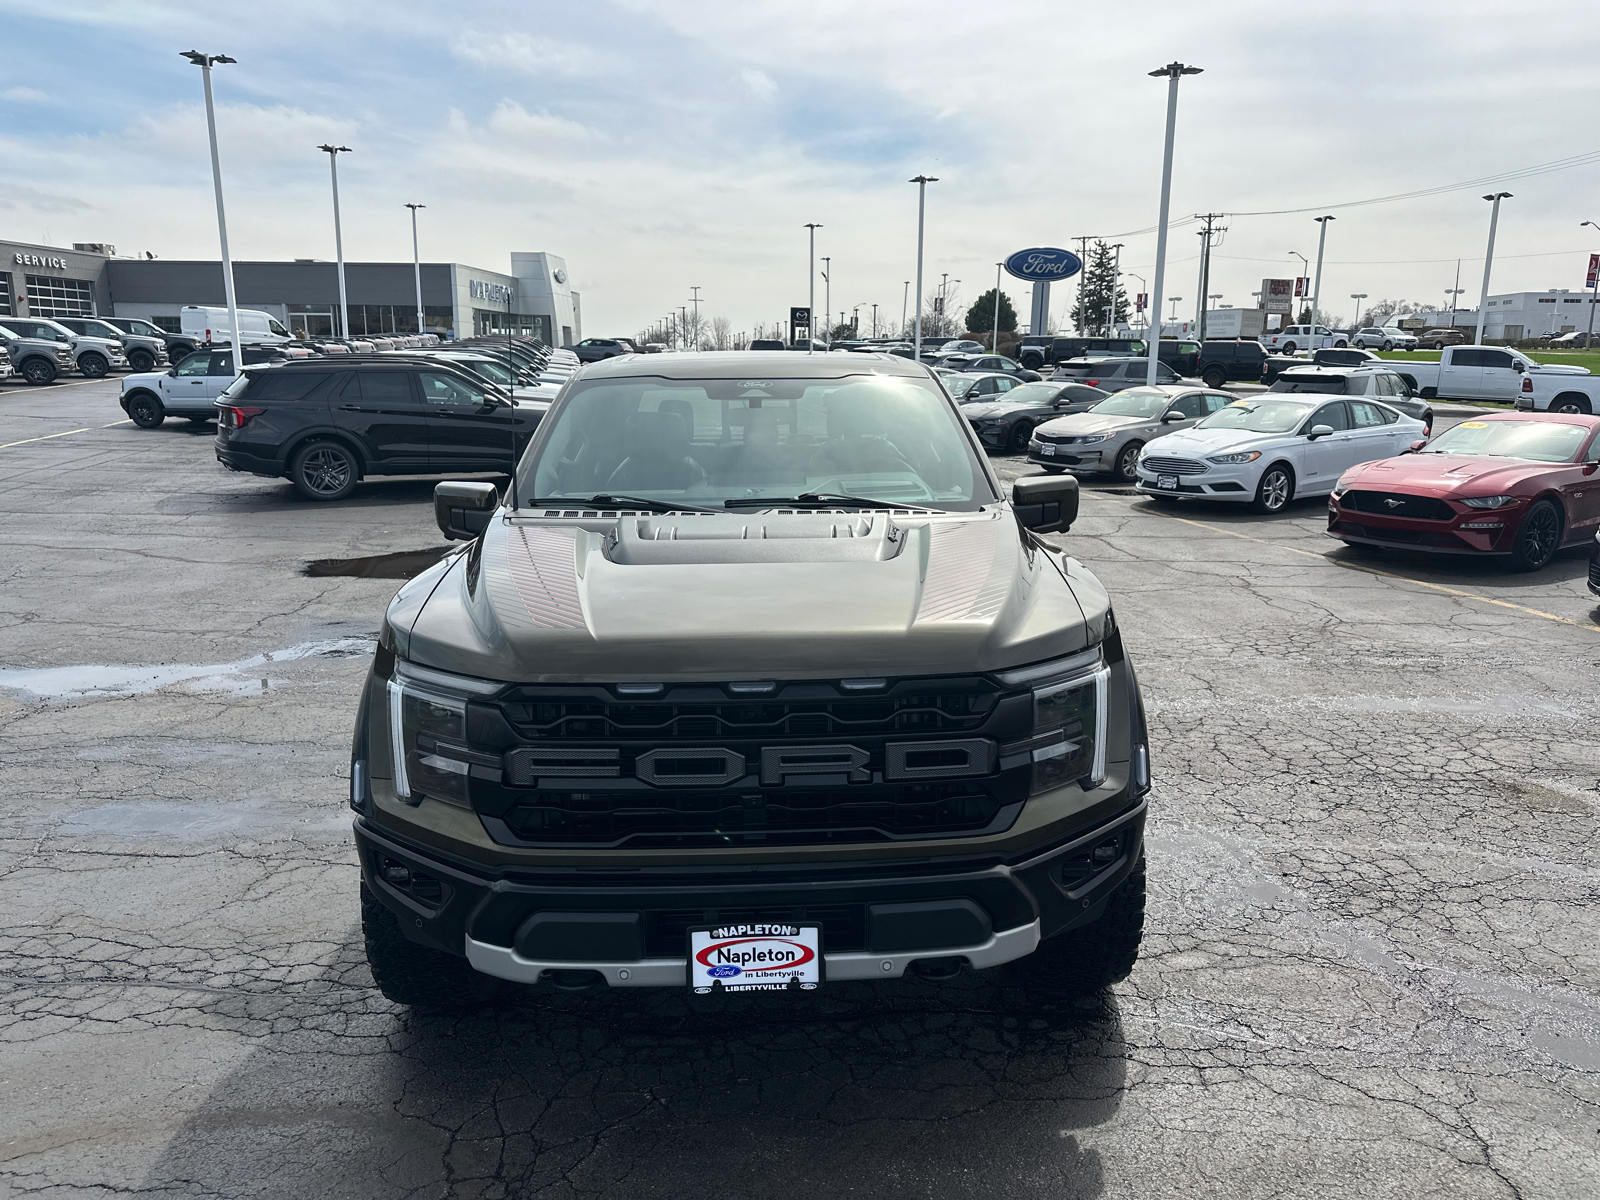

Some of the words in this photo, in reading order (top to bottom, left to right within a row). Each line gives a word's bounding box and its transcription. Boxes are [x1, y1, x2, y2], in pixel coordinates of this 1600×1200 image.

[15, 252, 67, 269] SERVICE
[1023, 254, 1067, 273] Ford
[470, 280, 514, 304] NAPLETON
[510, 738, 996, 790] FORD
[718, 924, 792, 938] NAPLETON
[717, 947, 795, 966] Napleton
[714, 967, 735, 976] Ford
[755, 970, 805, 978] Libertyville
[725, 983, 788, 992] LIBERTYVILLE
